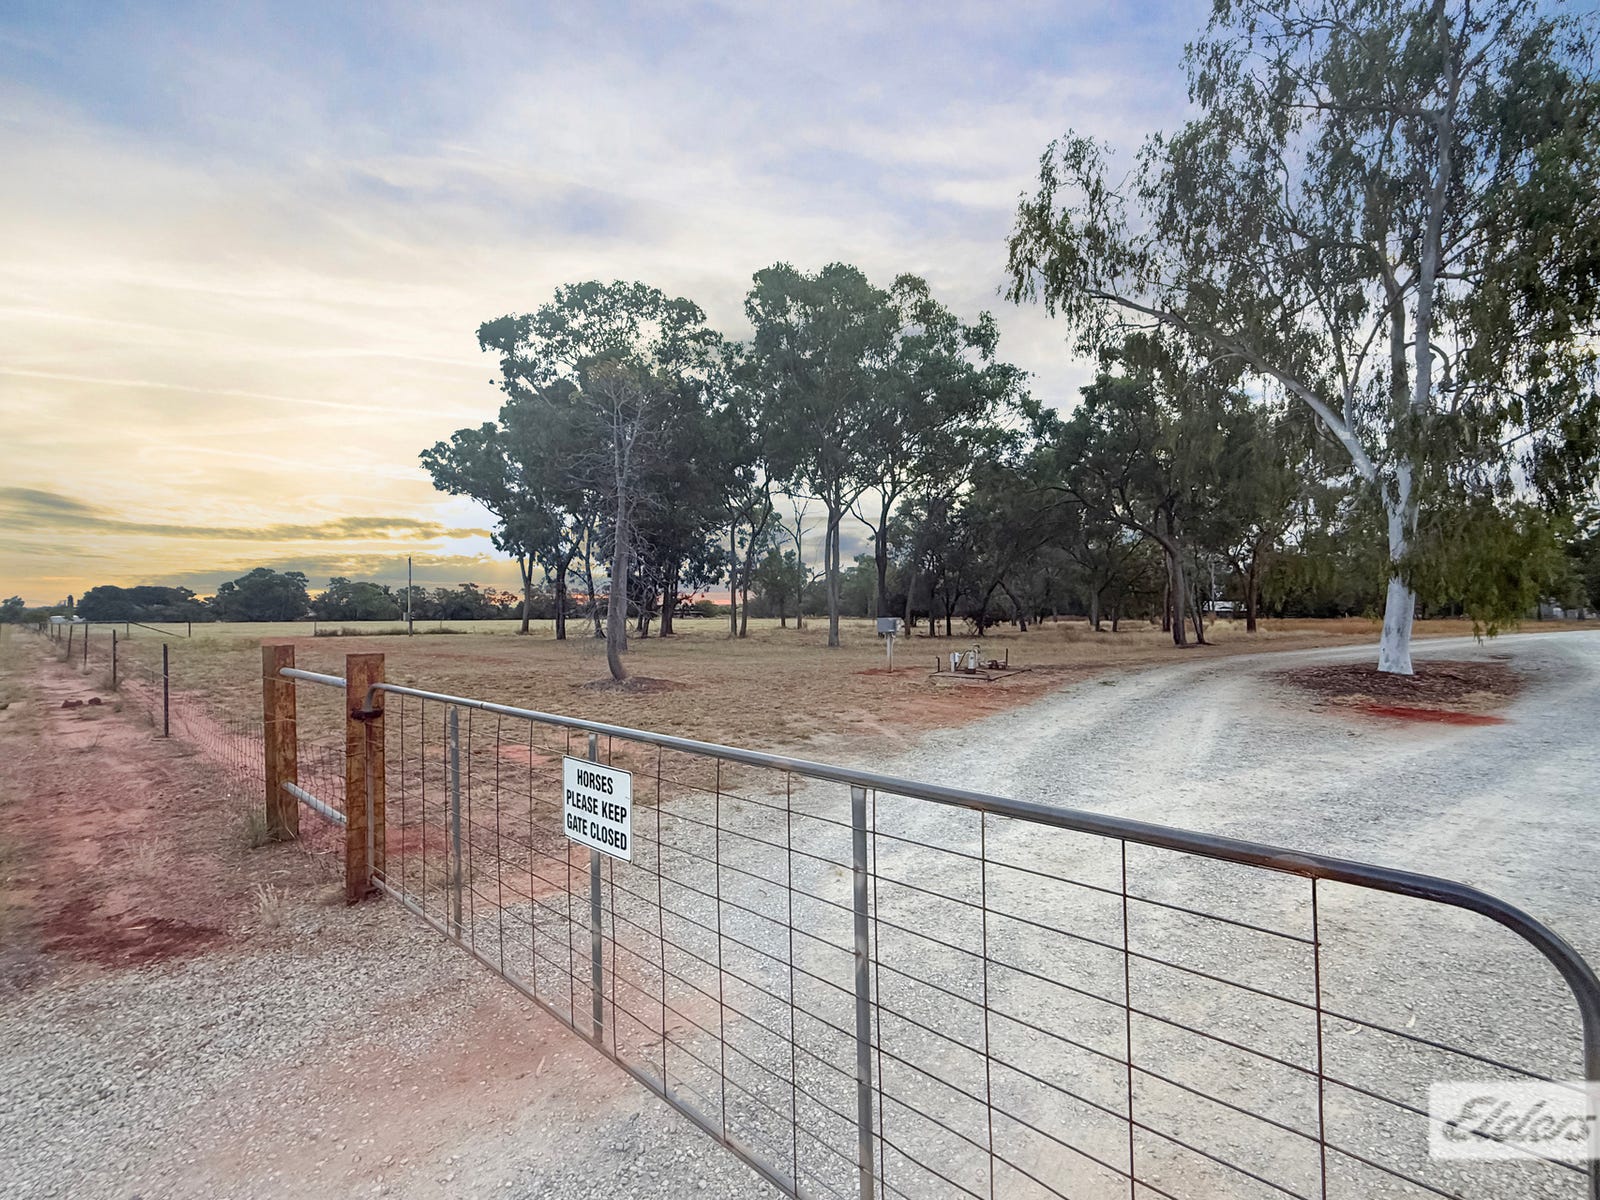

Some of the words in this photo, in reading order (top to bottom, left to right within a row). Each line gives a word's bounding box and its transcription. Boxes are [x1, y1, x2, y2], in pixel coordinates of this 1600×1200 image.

[577, 768, 613, 795] HORSES
[566, 789, 598, 815] PLEASE
[601, 800, 627, 824] KEEP
[566, 813, 588, 836] GATE
[590, 821, 627, 851] CLOSED
